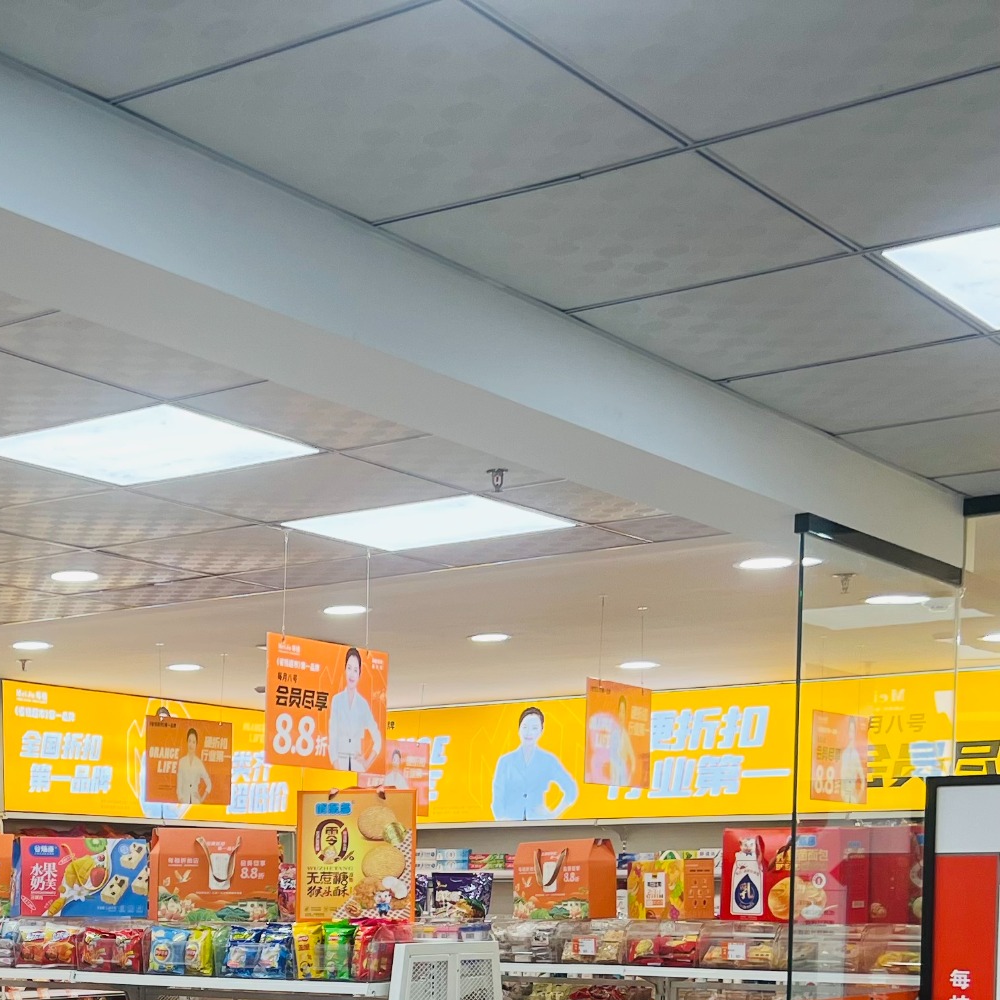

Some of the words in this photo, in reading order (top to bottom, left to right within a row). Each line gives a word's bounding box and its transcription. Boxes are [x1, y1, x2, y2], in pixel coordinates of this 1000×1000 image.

[276, 685, 329, 711] 会员尽享
[19, 730, 103, 761] 全国折扣
[273, 713, 327, 757] 8.8折
[149, 746, 179, 759] ORANGE
[157, 760, 177, 773] LIFE
[28, 763, 113, 794] 第一品牌
[607, 755, 790, 799] 业第一
[226, 781, 288, 815] 超低价
